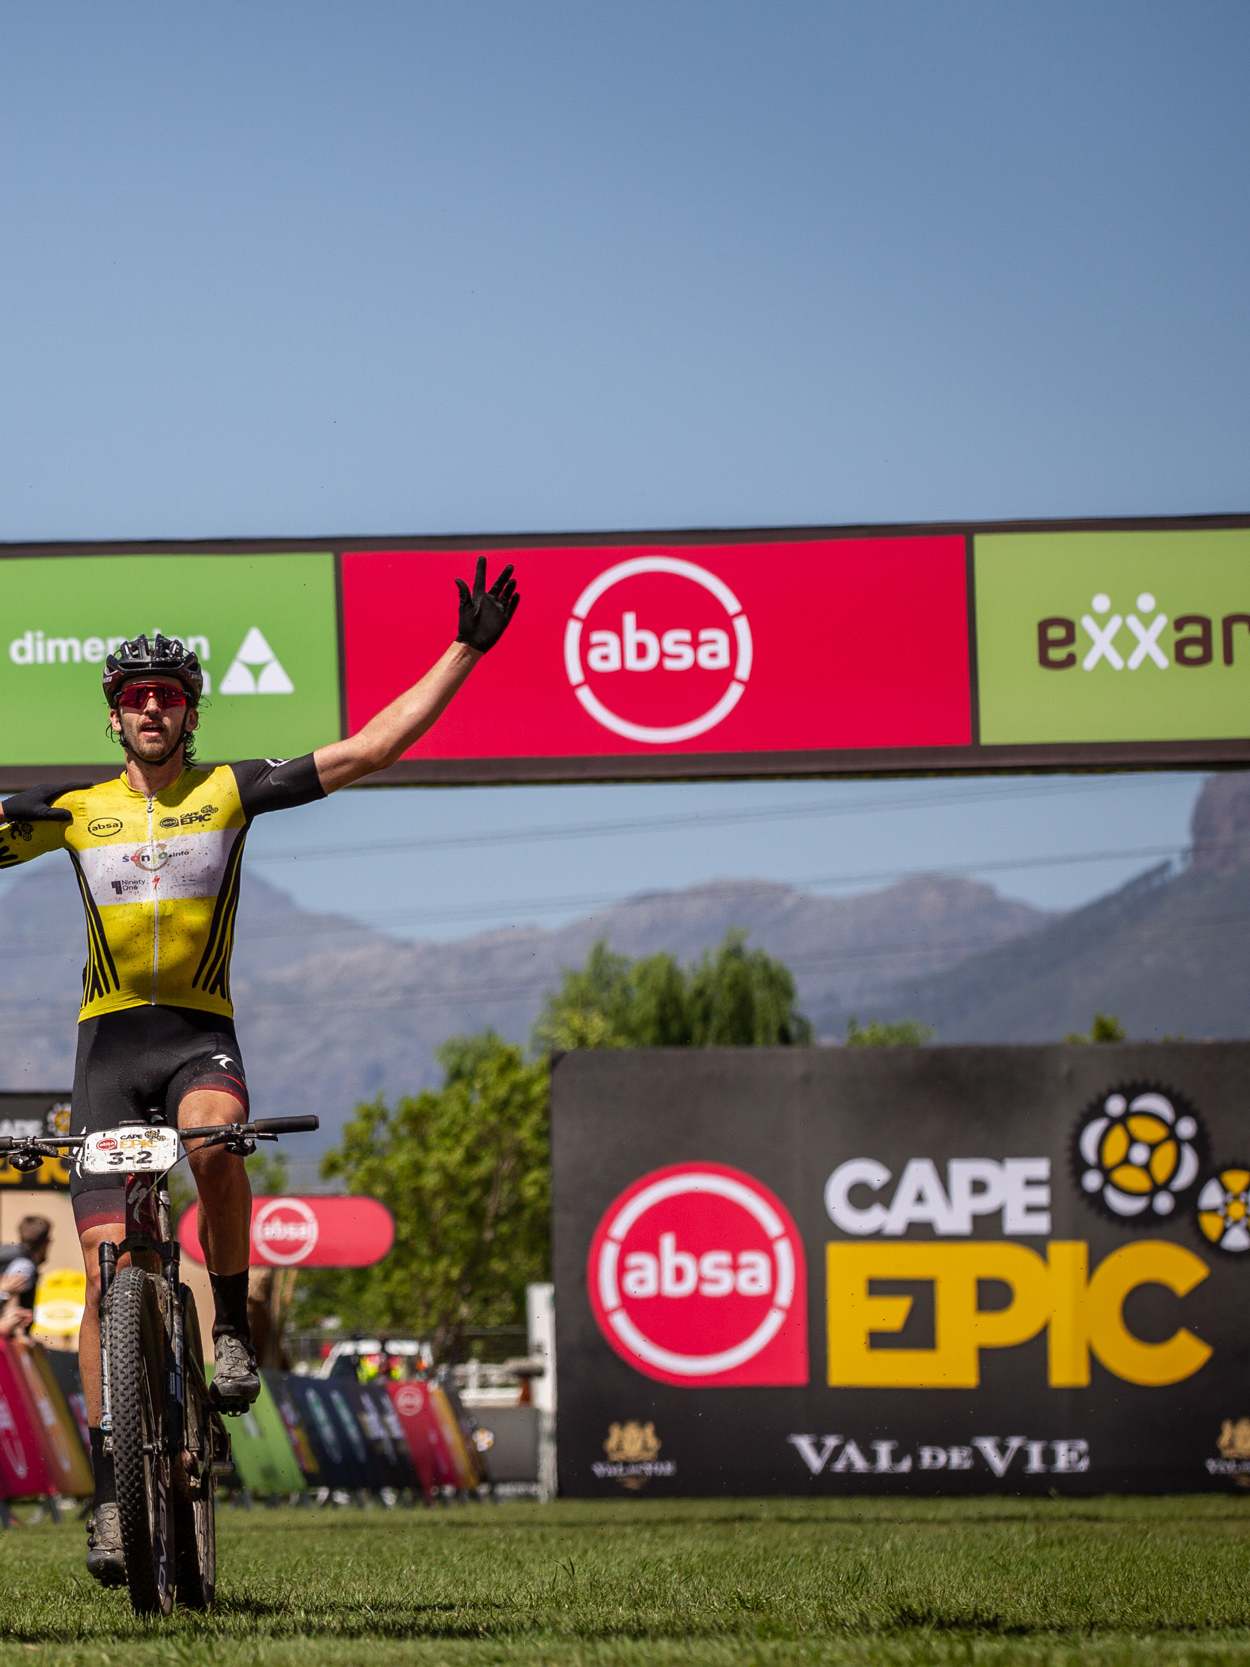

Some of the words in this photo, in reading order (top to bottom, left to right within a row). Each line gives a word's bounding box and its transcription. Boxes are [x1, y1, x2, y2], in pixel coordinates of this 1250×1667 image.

[588, 611, 730, 673] absa
[1037, 592, 1250, 671] exxar
[91, 821, 119, 832] absa
[180, 813, 212, 826] EPIC
[122, 878, 146, 886] Ninety
[106, 1150, 153, 1165] 3-2
[119, 1139, 158, 1149] EPIC
[823, 1156, 1052, 1237] CAPE
[622, 1231, 773, 1299] absa
[825, 1239, 1214, 1389] EPIC
[786, 1434, 913, 1476] VAL
[921, 1447, 972, 1470] DE
[971, 1435, 1091, 1478] VIE
